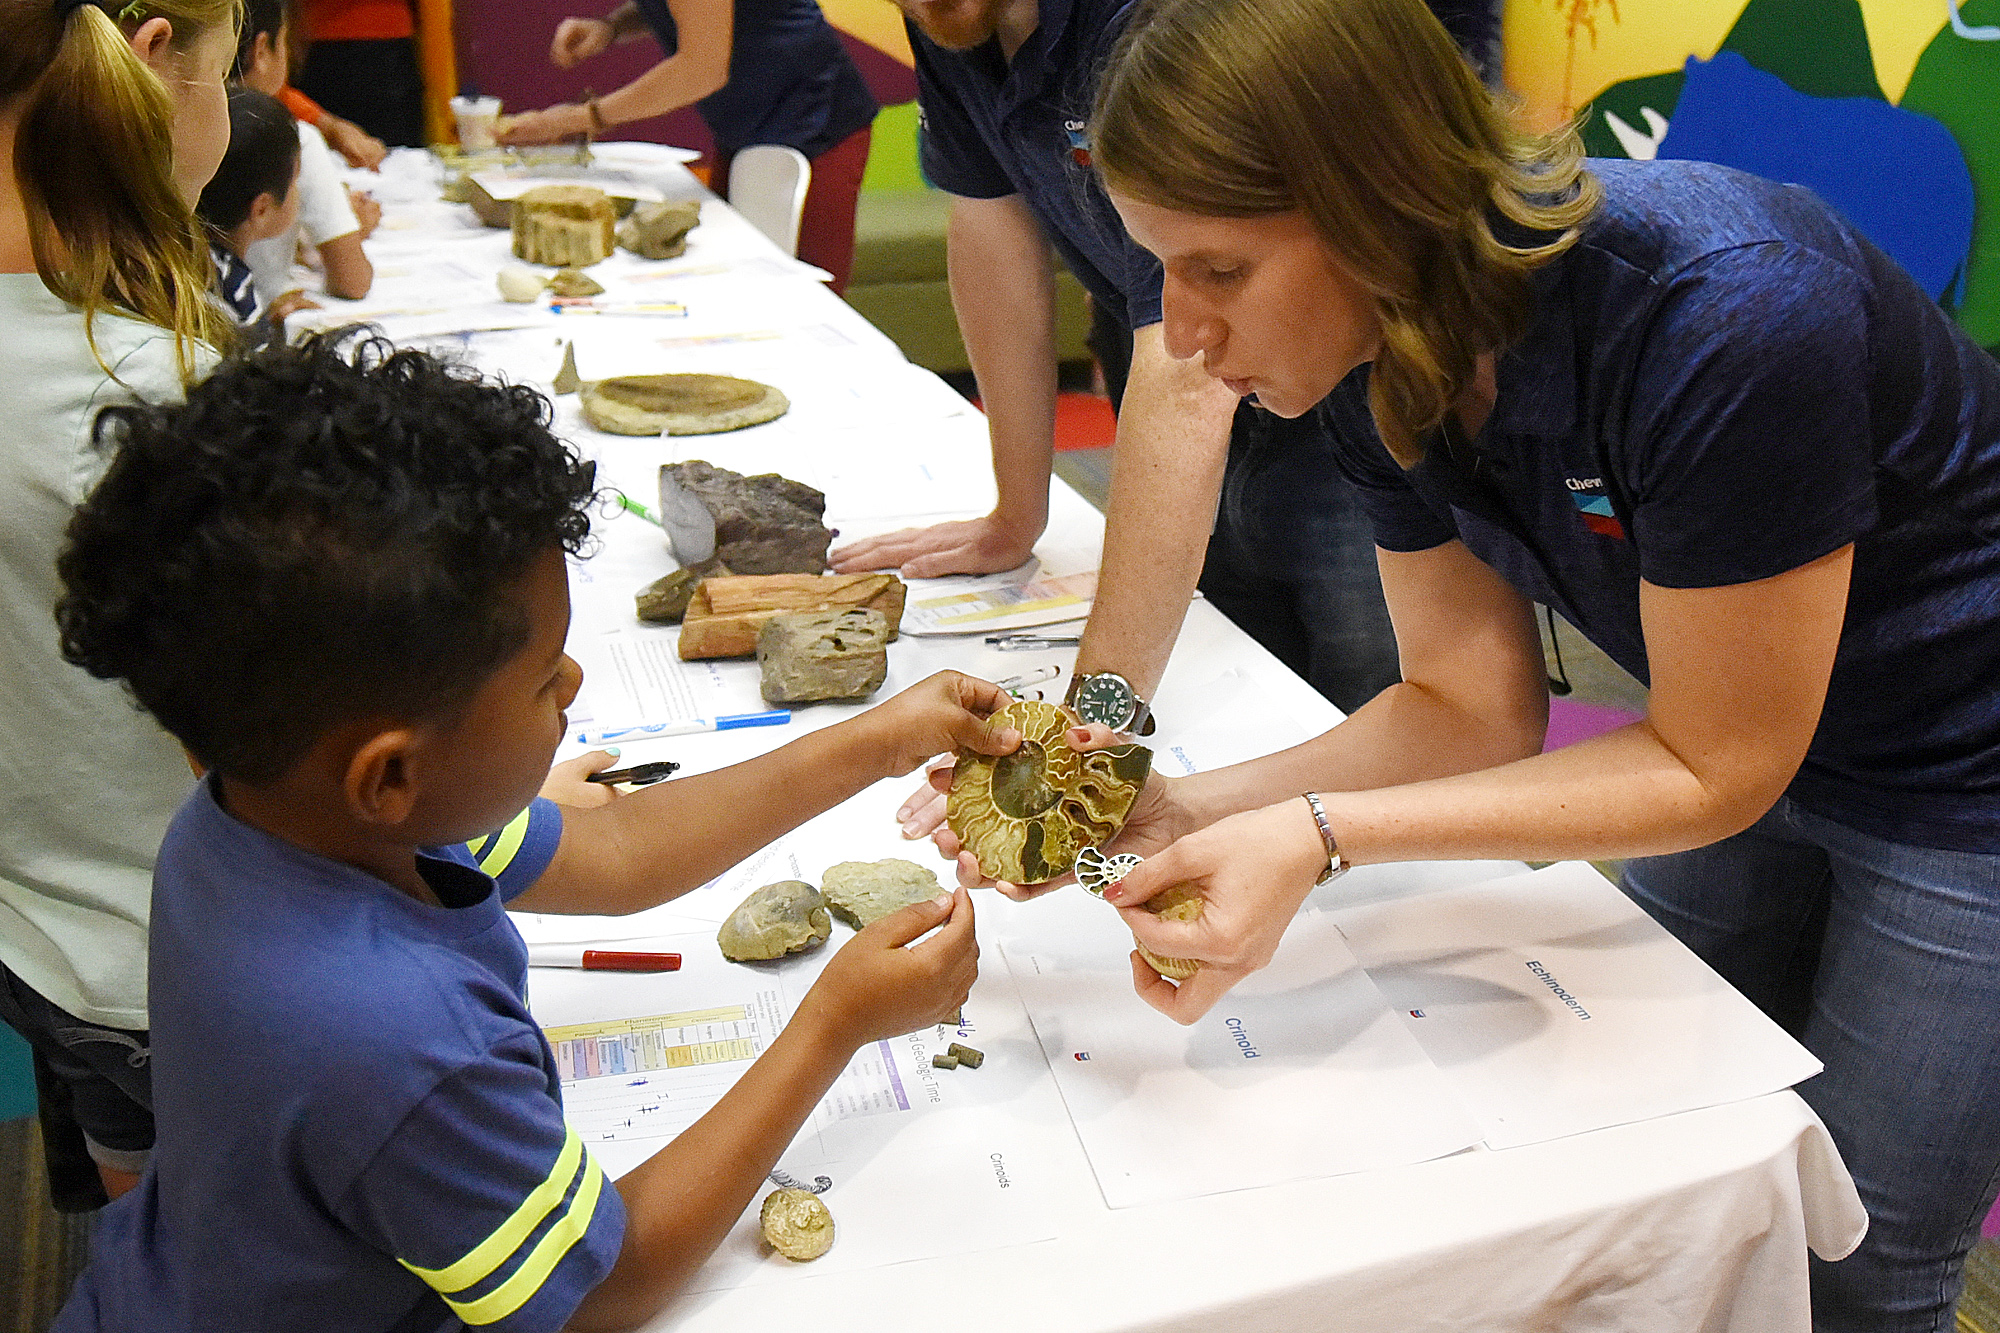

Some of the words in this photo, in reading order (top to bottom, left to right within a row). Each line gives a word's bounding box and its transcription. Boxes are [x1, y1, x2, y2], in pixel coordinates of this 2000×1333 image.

[1170, 745, 1197, 775] Brachio
[1525, 960, 1592, 1021] Echinoderm
[908, 1032, 919, 1043] nd
[1225, 1017, 1262, 1059] Crinoid
[911, 1043, 933, 1081] Geologic
[924, 1081, 942, 1104] Time
[990, 1152, 1011, 1189] Crinoids
